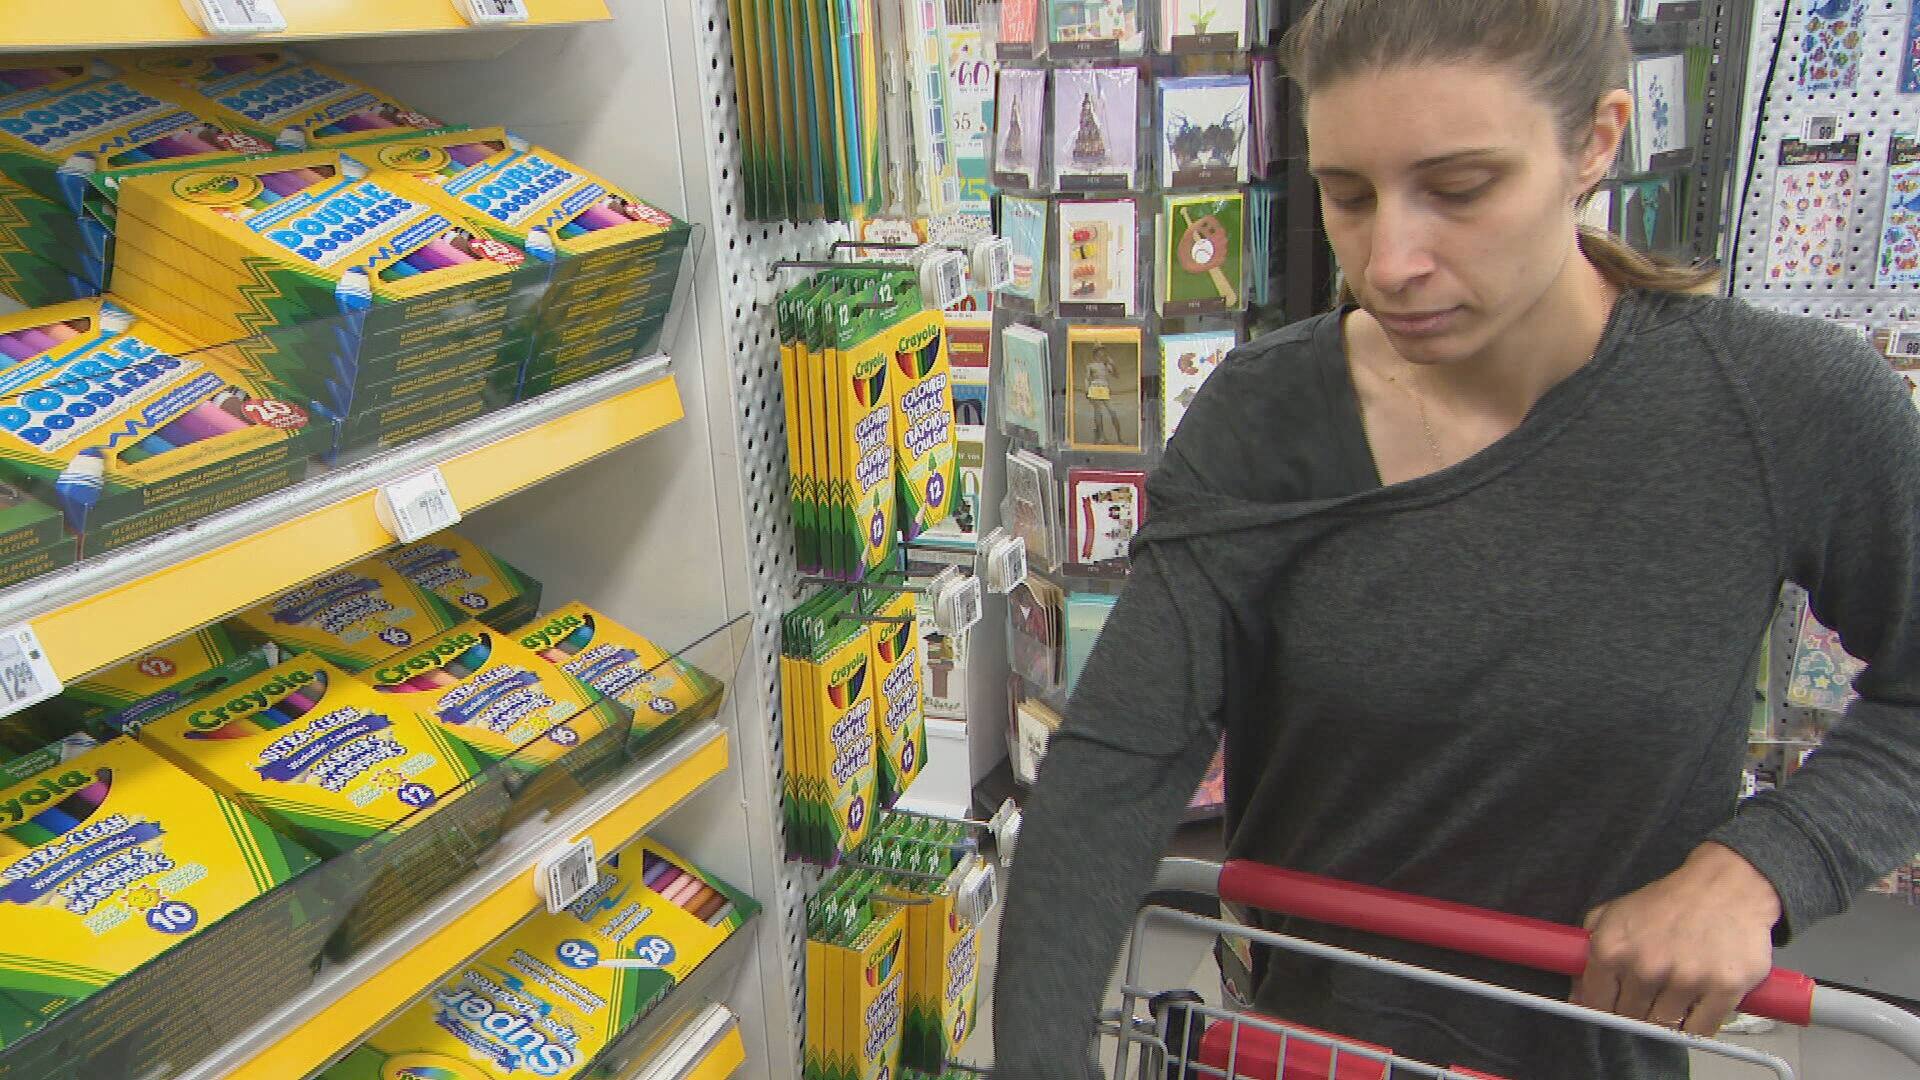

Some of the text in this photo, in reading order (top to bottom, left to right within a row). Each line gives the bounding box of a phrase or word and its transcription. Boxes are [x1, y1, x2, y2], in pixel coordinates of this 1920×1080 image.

[460, 154, 556, 212] DOUBLE
[487, 169, 574, 223] DOODLERS
[262, 182, 394, 250] DOUBLE
[296, 198, 414, 263] DOODLERS
[880, 284, 894, 303] 12
[898, 325, 938, 353] Crayola
[0, 337, 158, 433] DOUBLE
[18, 352, 182, 446] DOODLERS
[902, 372, 948, 413] COLOURED
[856, 406, 890, 442] COLOURED
[906, 391, 944, 427] PENCILS
[929, 481, 941, 500] 12
[872, 520, 882, 538] 12
[520, 614, 582, 649] ayola
[374, 631, 479, 685] Crayola
[831, 652, 865, 683] Crayola
[188, 669, 315, 731] Crayola
[401, 785, 432, 804] 12
[1, 813, 129, 883] ULTRA-CLEAN
[57, 846, 150, 903] MARKERS
[65, 851, 177, 916] MARQUEURS
[152, 903, 193, 931] 10
[559, 942, 597, 966] 20
[639, 938, 671, 964] 20
[433, 982, 575, 1076] Super
